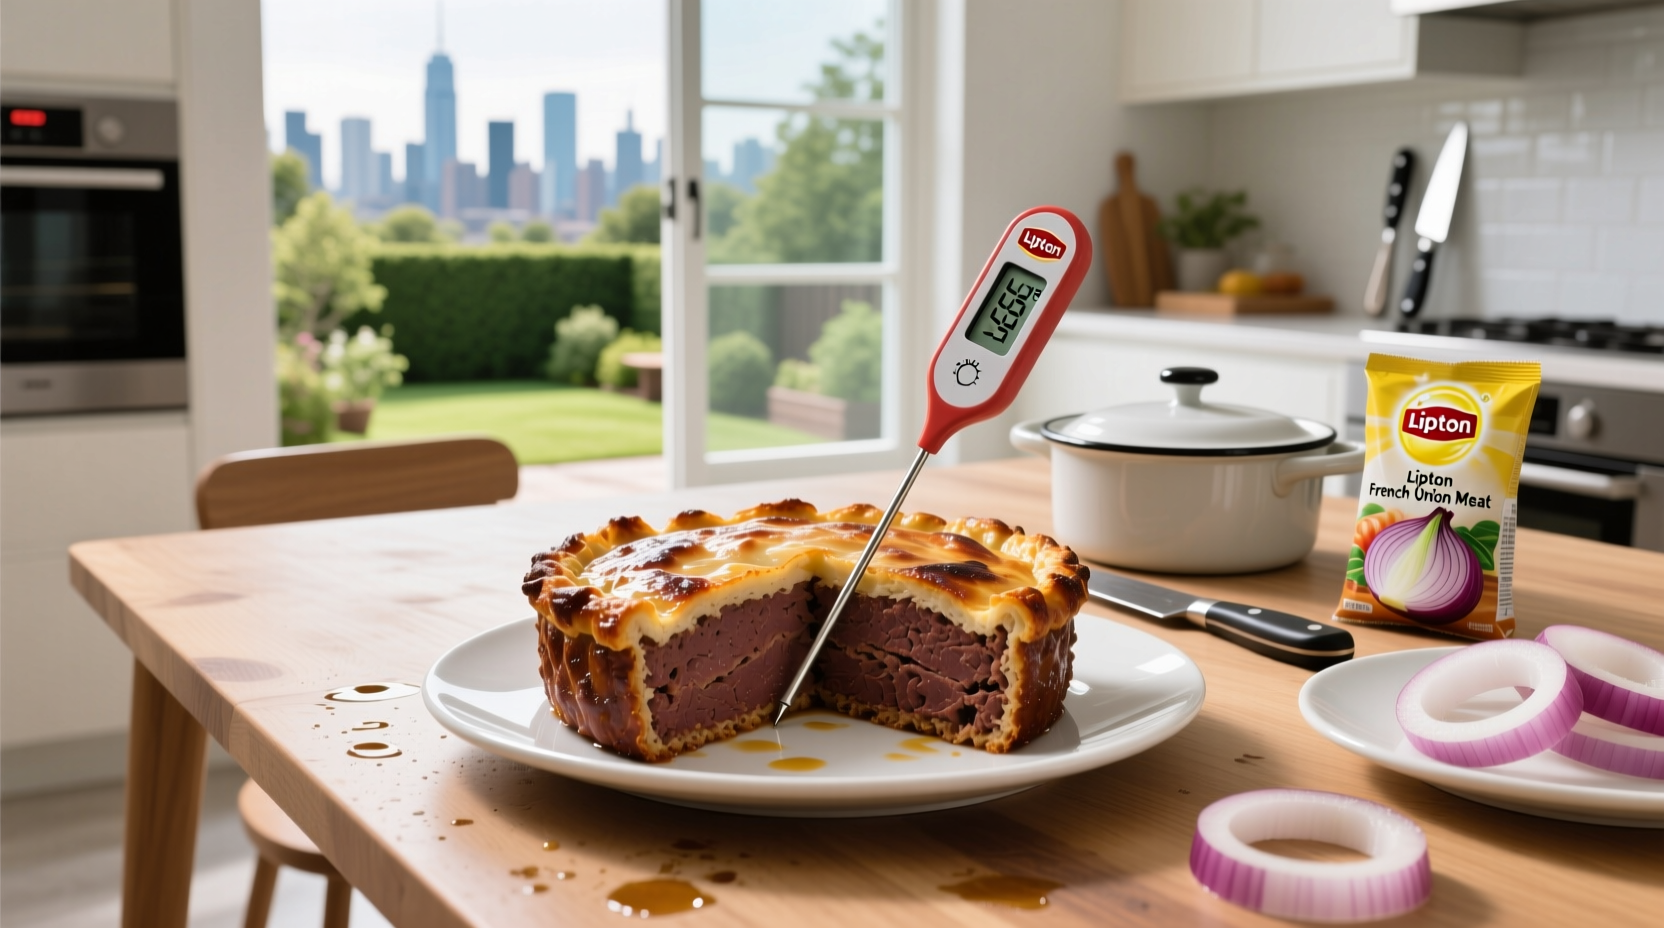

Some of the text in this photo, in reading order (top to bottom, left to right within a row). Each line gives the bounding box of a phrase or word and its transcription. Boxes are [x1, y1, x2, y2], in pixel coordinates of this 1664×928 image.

[1408, 411, 1471, 434] Lipton
[1406, 469, 1453, 488] Lipton
[1369, 482, 1410, 500] French
[1455, 490, 1492, 509] Meat
